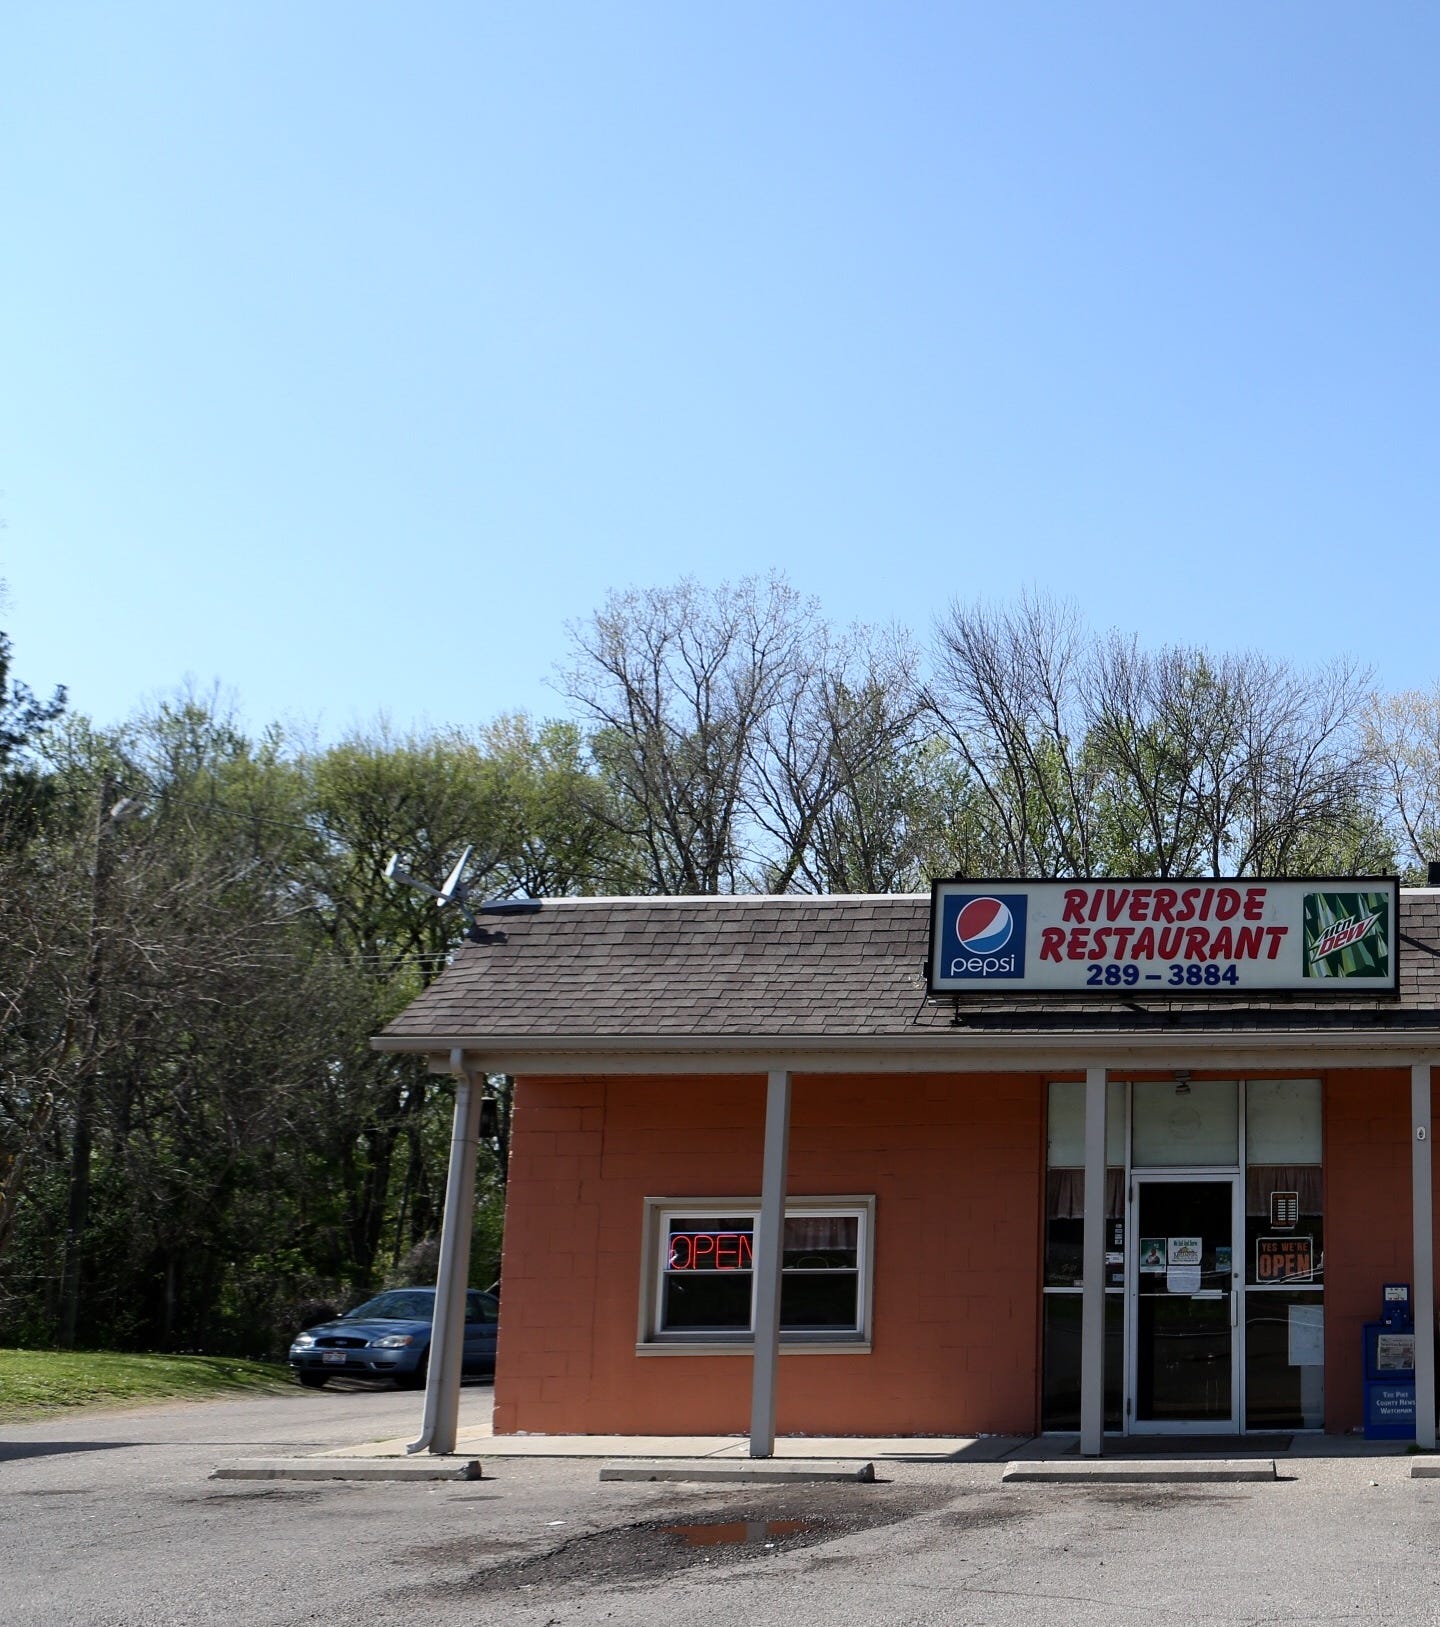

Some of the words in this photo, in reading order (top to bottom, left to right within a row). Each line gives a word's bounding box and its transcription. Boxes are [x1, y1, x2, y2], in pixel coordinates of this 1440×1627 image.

[1062, 888, 1267, 925] RIVERSIDE
[1039, 926, 1289, 962] RESTAURANT
[950, 955, 1015, 977] pepsi
[671, 1235, 753, 1270] OPEN
[1261, 1242, 1278, 1252] YES
[1281, 1241, 1310, 1252] WE'RE
[1259, 1254, 1310, 1278] OPEN
